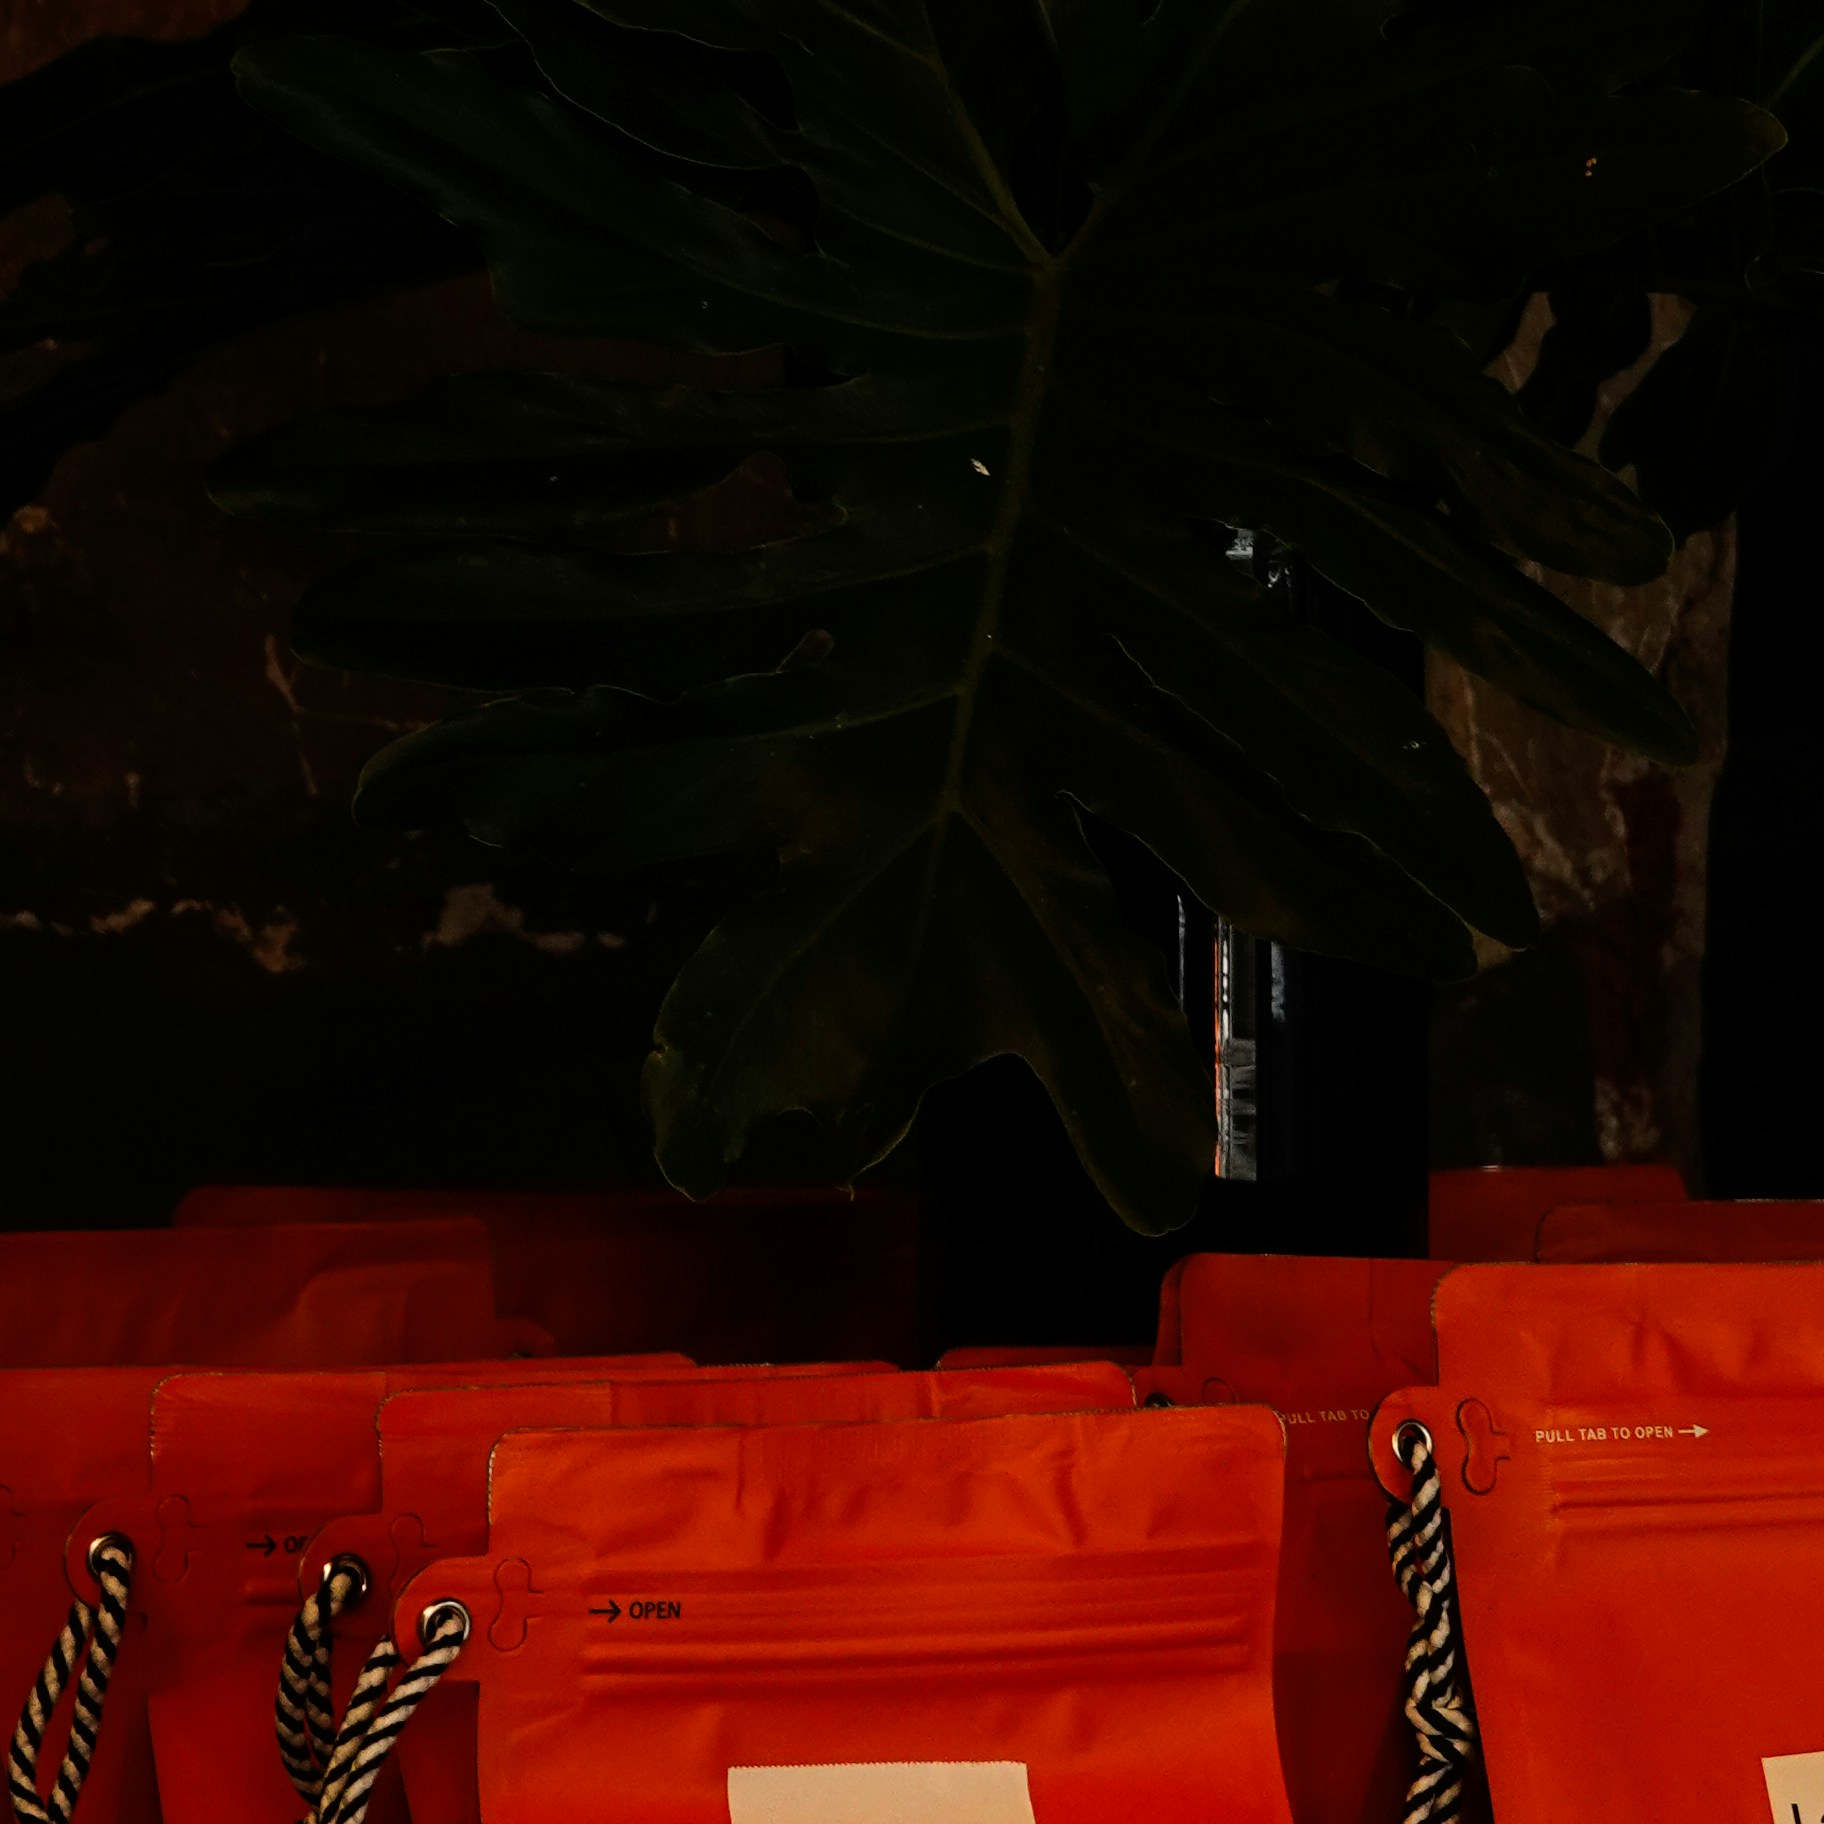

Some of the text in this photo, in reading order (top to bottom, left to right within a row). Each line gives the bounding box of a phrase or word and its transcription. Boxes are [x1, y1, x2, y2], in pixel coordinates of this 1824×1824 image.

[1318, 1409, 1347, 1422] TAB
[1351, 1408, 1370, 1421] TO
[1535, 1425, 1674, 1443] PULL TAB TO OPEN
[628, 1601, 682, 1619] OPEN
